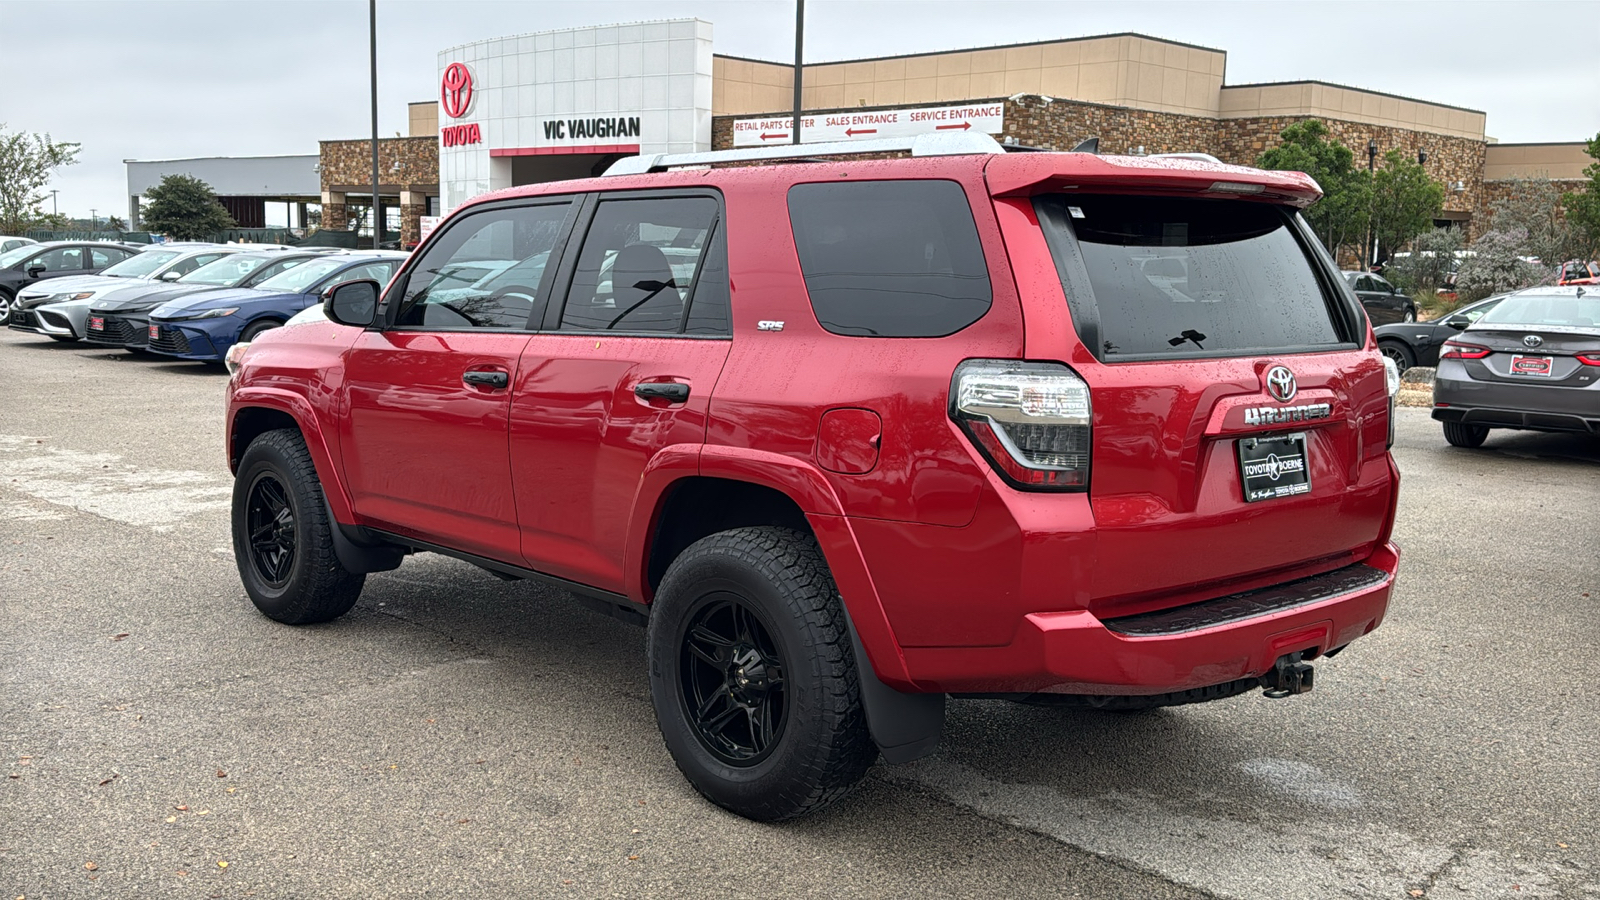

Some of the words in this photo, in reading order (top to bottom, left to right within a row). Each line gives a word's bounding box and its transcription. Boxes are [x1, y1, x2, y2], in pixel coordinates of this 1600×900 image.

[826, 116, 850, 126] SALES
[852, 113, 897, 125] ENTRANCE
[910, 110, 947, 122] SERVICE
[949, 106, 1001, 120] ENTRANCE
[543, 120, 565, 140] VIC
[568, 116, 640, 139] VAUGHAN
[735, 122, 758, 131] RETAIL
[760, 120, 782, 130] PARTS
[785, 119, 814, 129] CETER
[441, 123, 481, 147] TOYOTA
[1245, 463, 1270, 475] TOYOTA
[1280, 459, 1303, 470] BOERNE
